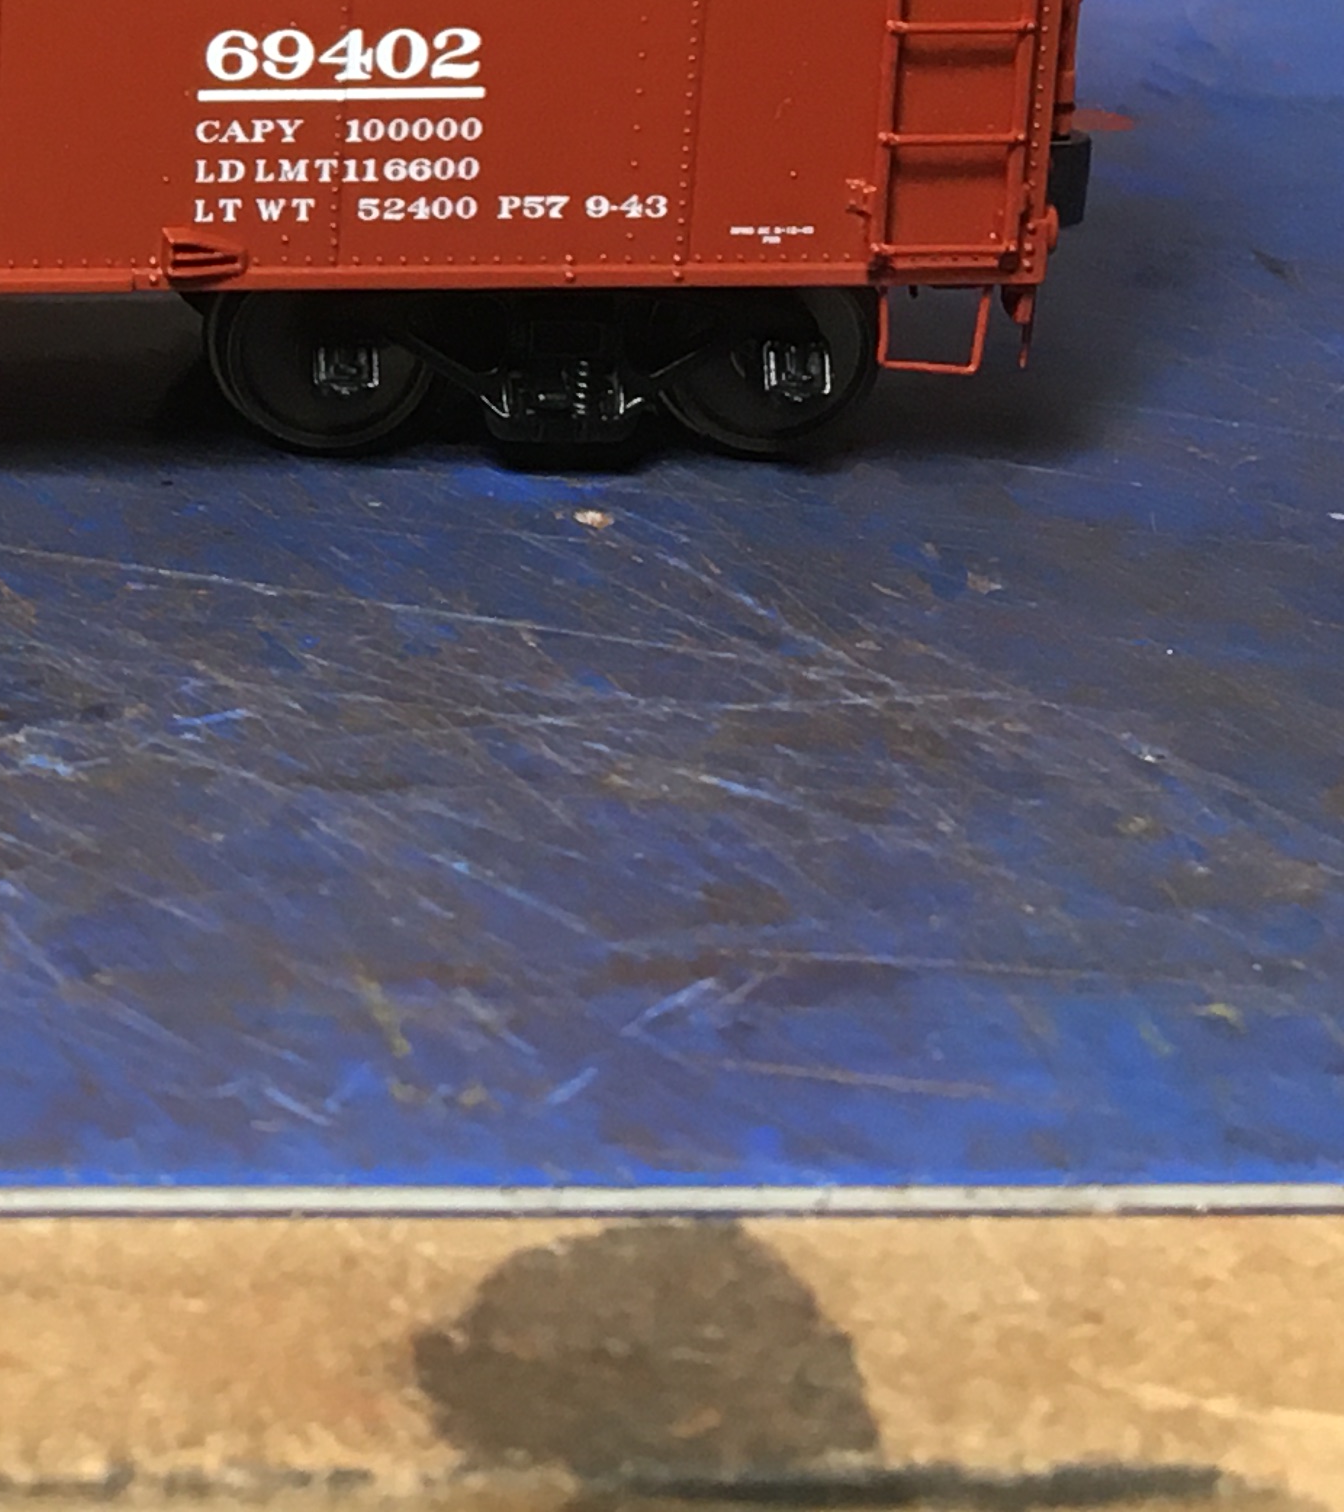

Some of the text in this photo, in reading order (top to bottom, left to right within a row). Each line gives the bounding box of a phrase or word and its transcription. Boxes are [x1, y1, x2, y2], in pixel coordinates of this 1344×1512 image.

[205, 28, 481, 82] 69402
[196, 117, 482, 143] CAPY 100000
[196, 159, 245, 183] LD
[342, 157, 480, 182] 116600
[194, 195, 667, 222] LT WT 52400 P57 9-43
